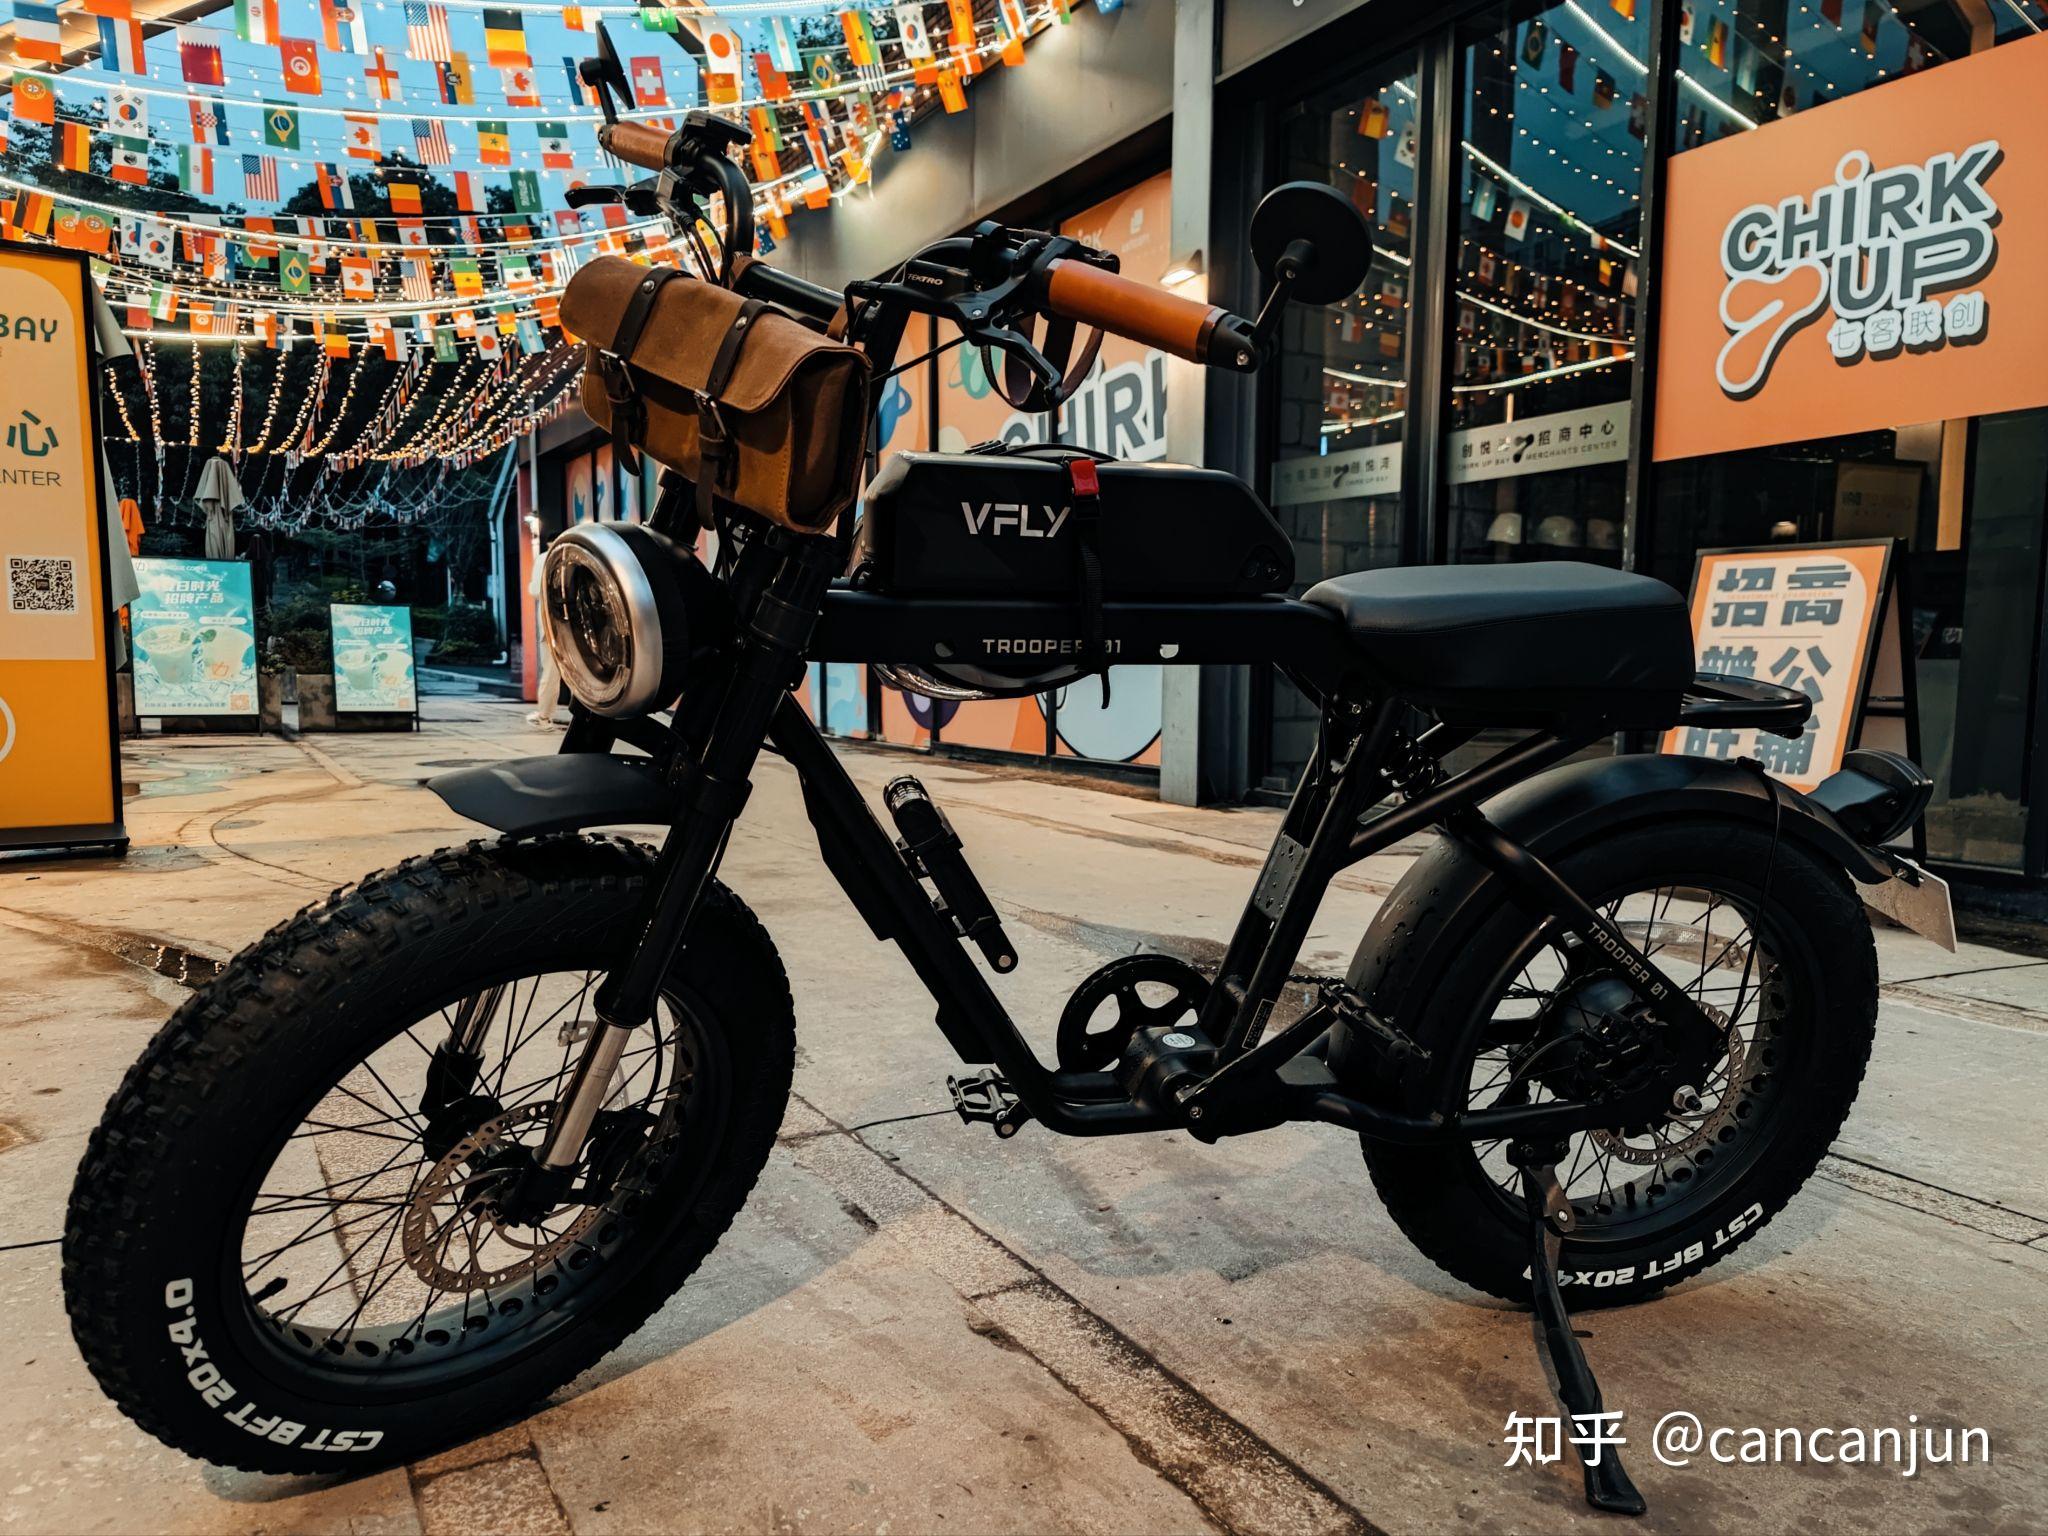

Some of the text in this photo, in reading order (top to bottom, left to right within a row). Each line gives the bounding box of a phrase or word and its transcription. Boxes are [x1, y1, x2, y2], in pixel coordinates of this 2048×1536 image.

[906, 273, 944, 286] TEKTRO
[1830, 220, 1994, 318] UP
[1827, 290, 1985, 358] 七客联创
[7, 410, 59, 457] 心
[1526, 447, 1578, 461] MERCHANTS
[1581, 440, 1618, 453] CENTER
[1538, 420, 1615, 446] 招商中心
[0, 468, 62, 487] NTER
[961, 501, 1071, 538] VFLY
[1712, 565, 1852, 628] 招商
[982, 639, 1083, 654] TROOPER
[1588, 922, 1669, 1000] TROOPER 01
[1712, 1202, 1764, 1250] CST
[1642, 1241, 1705, 1279] BFT
[223, 1402, 307, 1446] BFT
[300, 1428, 385, 1452] CST
